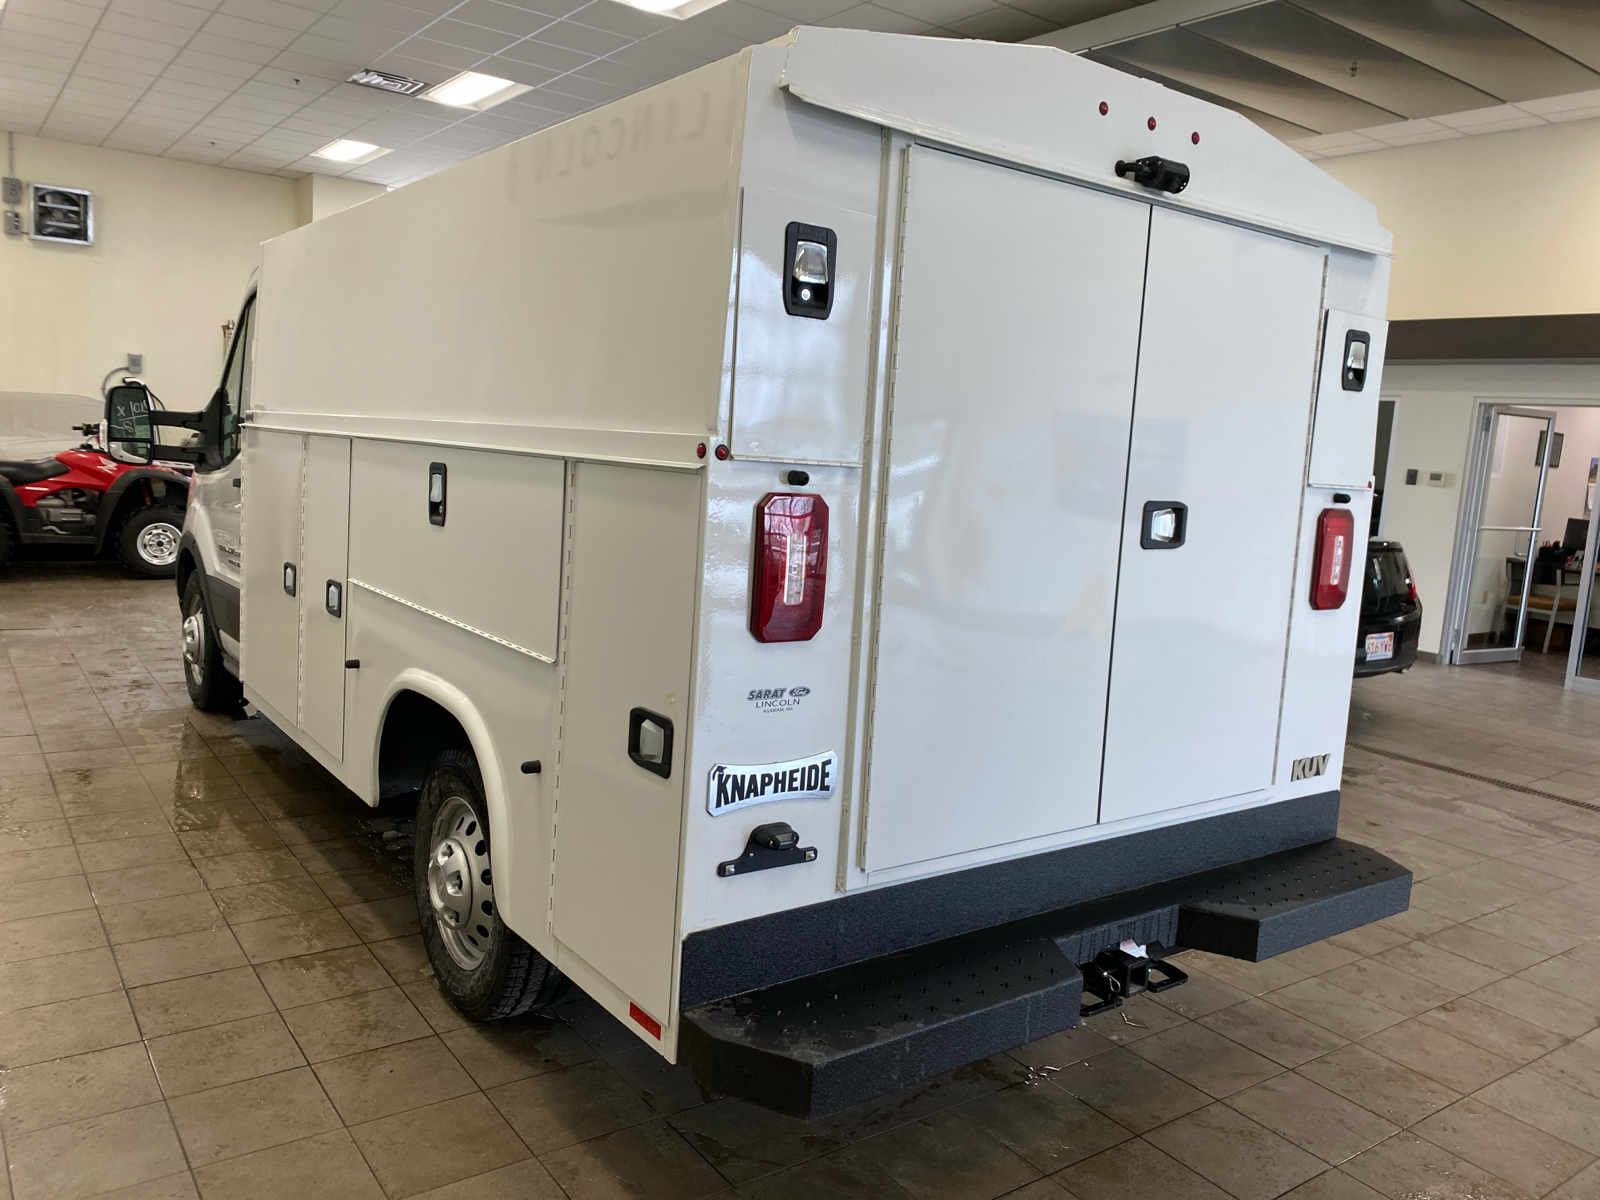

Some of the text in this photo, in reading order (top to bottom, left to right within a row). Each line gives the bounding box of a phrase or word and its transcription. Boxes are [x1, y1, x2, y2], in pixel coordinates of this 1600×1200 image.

[747, 687, 787, 701] SARAT
[755, 698, 800, 708] LINCOLN
[1290, 753, 1331, 782] KUV
[715, 758, 832, 808] KNAPHEIDE
